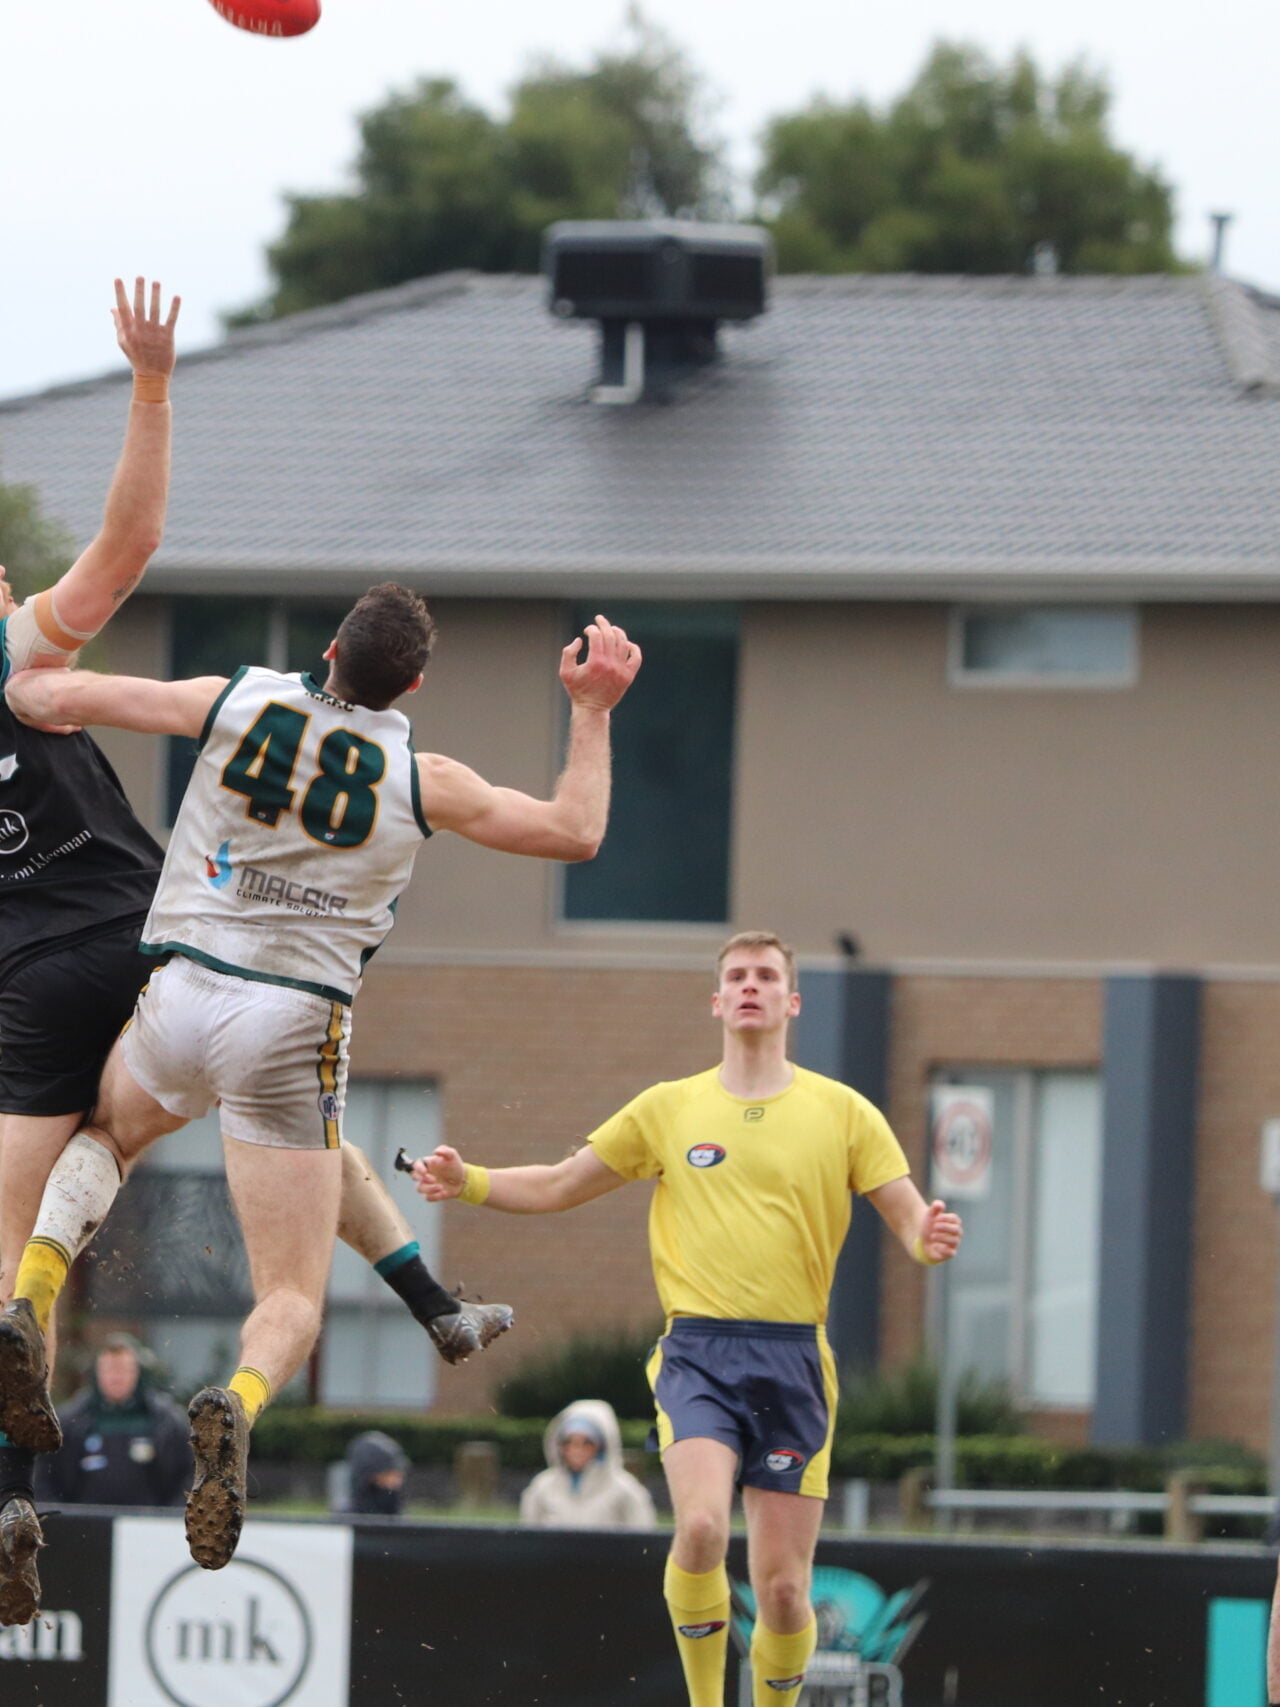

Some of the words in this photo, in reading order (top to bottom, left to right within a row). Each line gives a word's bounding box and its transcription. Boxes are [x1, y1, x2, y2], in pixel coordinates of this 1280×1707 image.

[219, 699, 388, 849] 48
[237, 889, 281, 906] CLIMATE
[239, 866, 349, 916] MACAIR
[176, 1594, 282, 1665] mk
